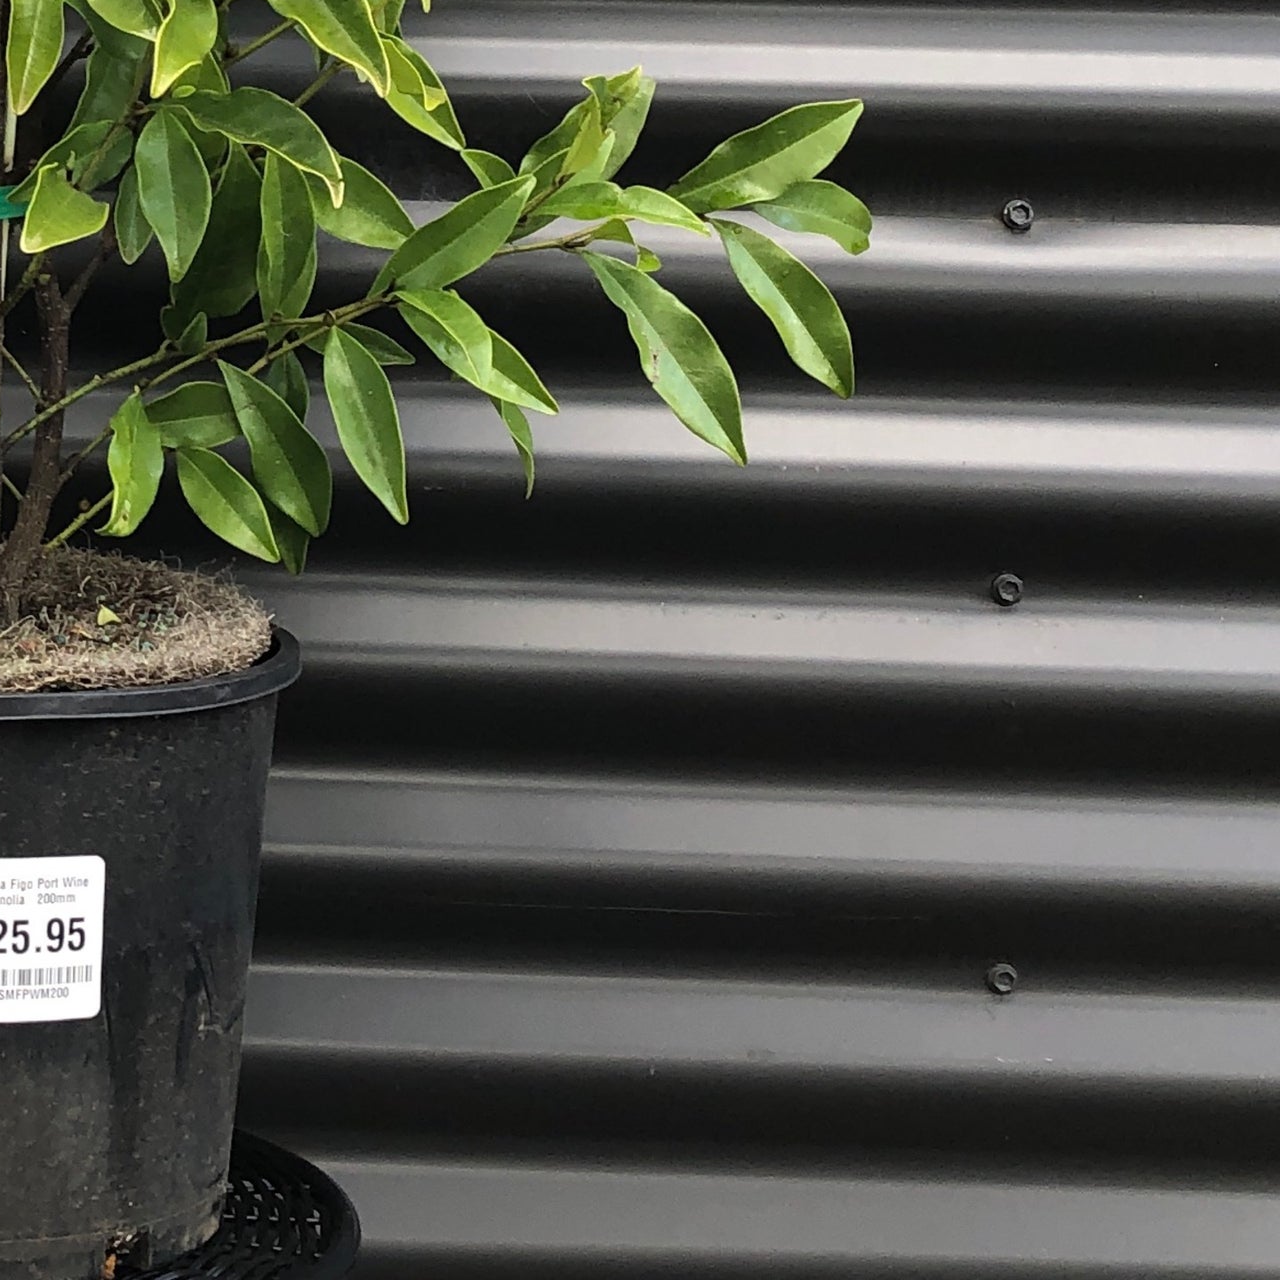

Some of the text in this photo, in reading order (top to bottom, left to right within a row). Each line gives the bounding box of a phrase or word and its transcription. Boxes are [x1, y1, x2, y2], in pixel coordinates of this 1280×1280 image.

[11, 879, 33, 891] Figo
[38, 878, 58, 889] Port
[63, 877, 88, 888] Wine
[37, 893, 75, 904] 200mm
